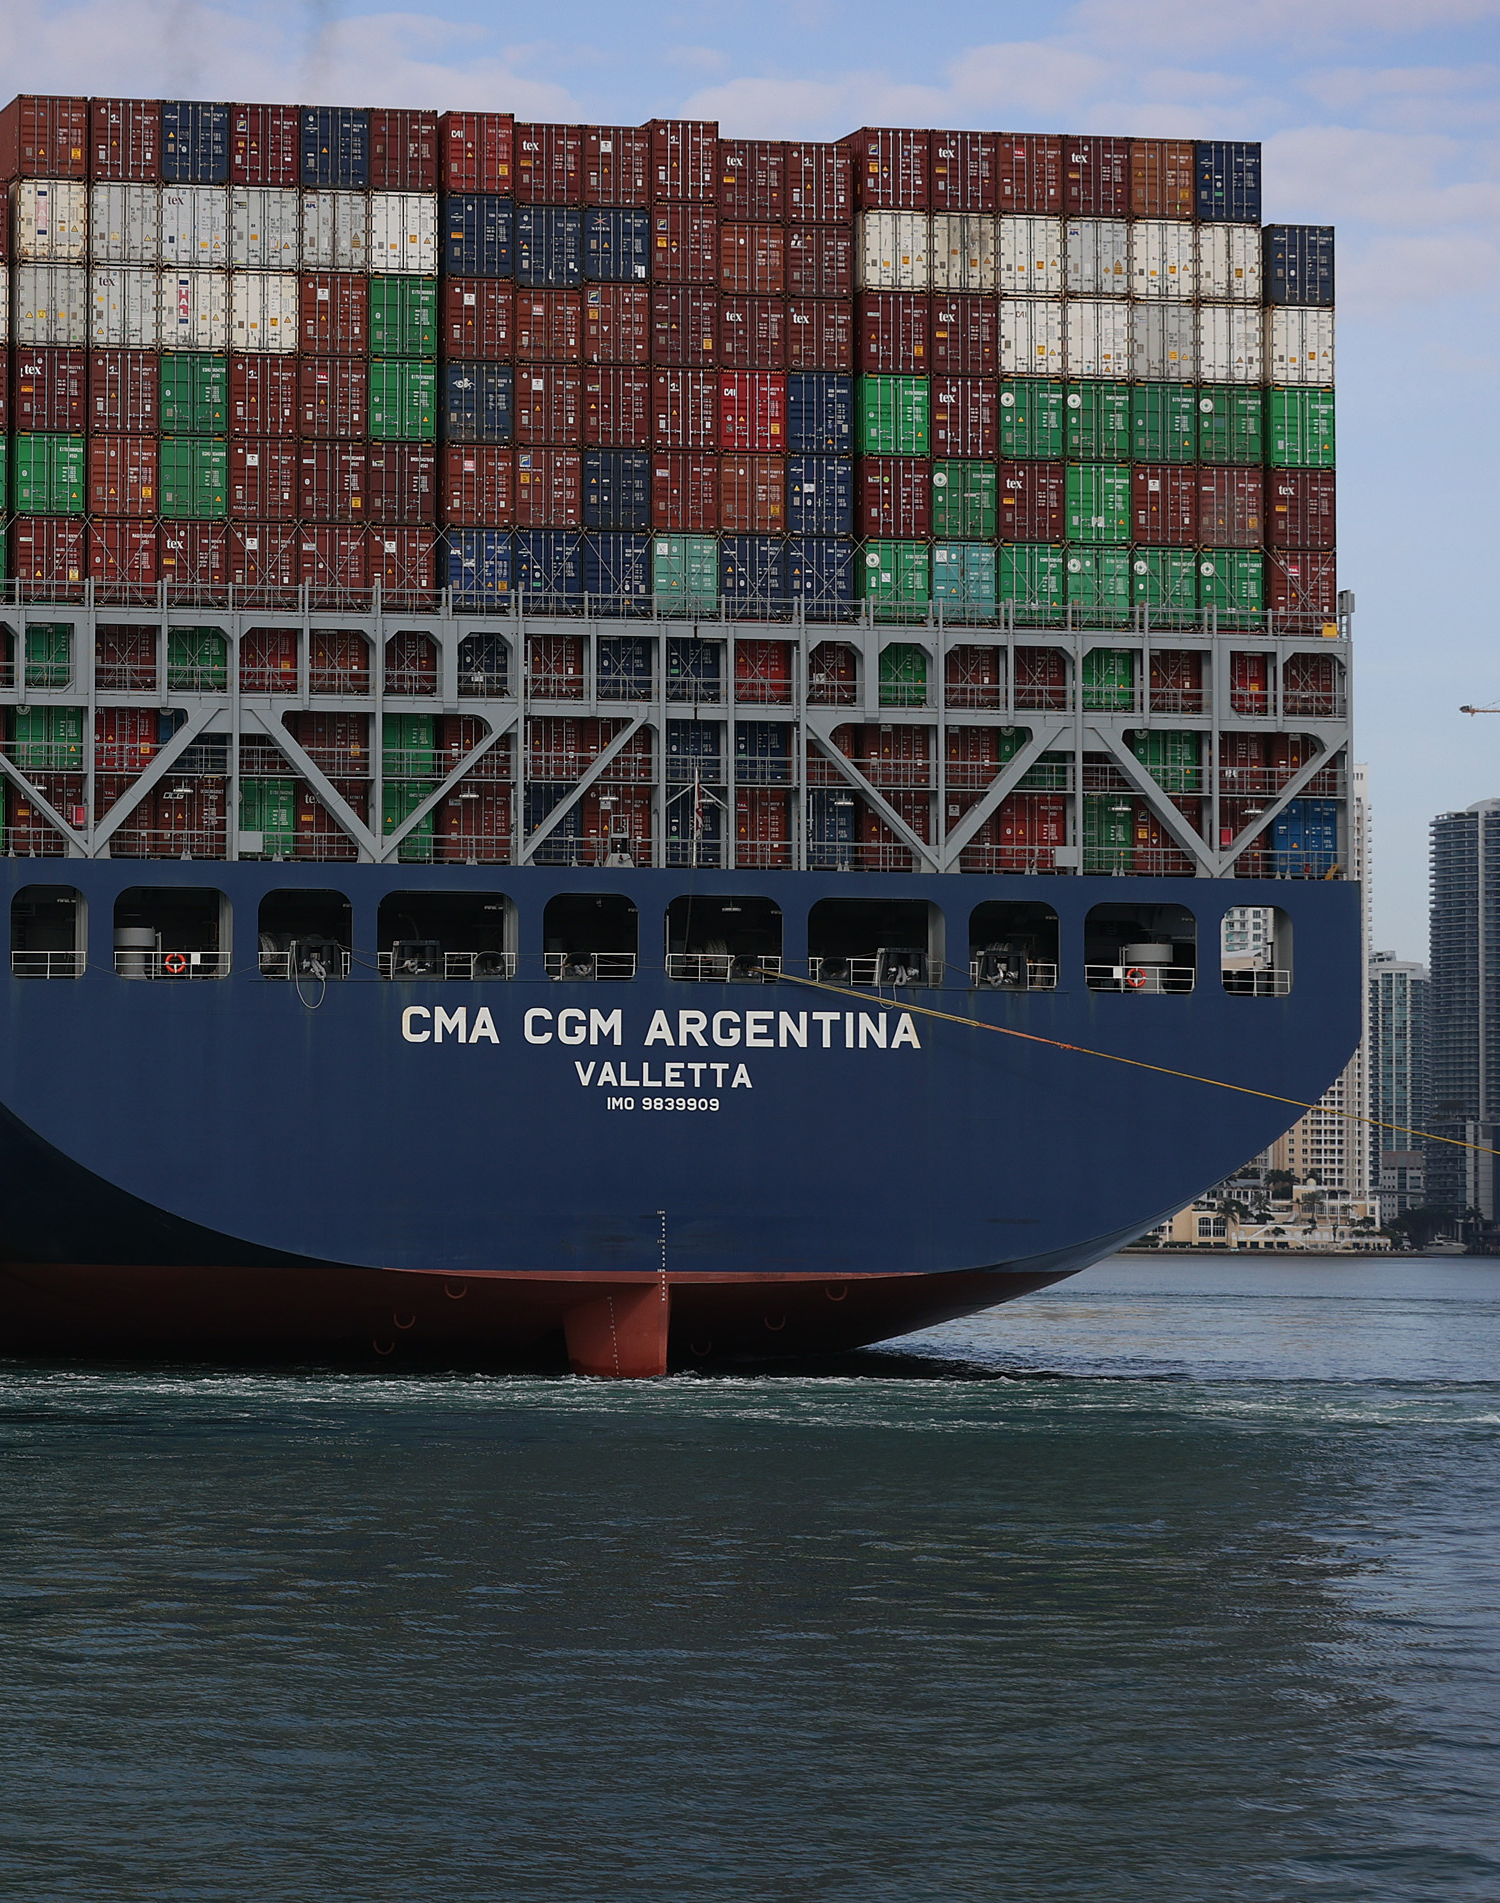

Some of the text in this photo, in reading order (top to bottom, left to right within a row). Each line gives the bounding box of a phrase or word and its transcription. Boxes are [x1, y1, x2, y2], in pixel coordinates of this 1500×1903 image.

[723, 388, 736, 396] CAI
[401, 1006, 921, 1049] CMA CGM ARGENTINA
[574, 1061, 752, 1088] VALLETTA
[606, 1097, 719, 1112] IMO 9839909
